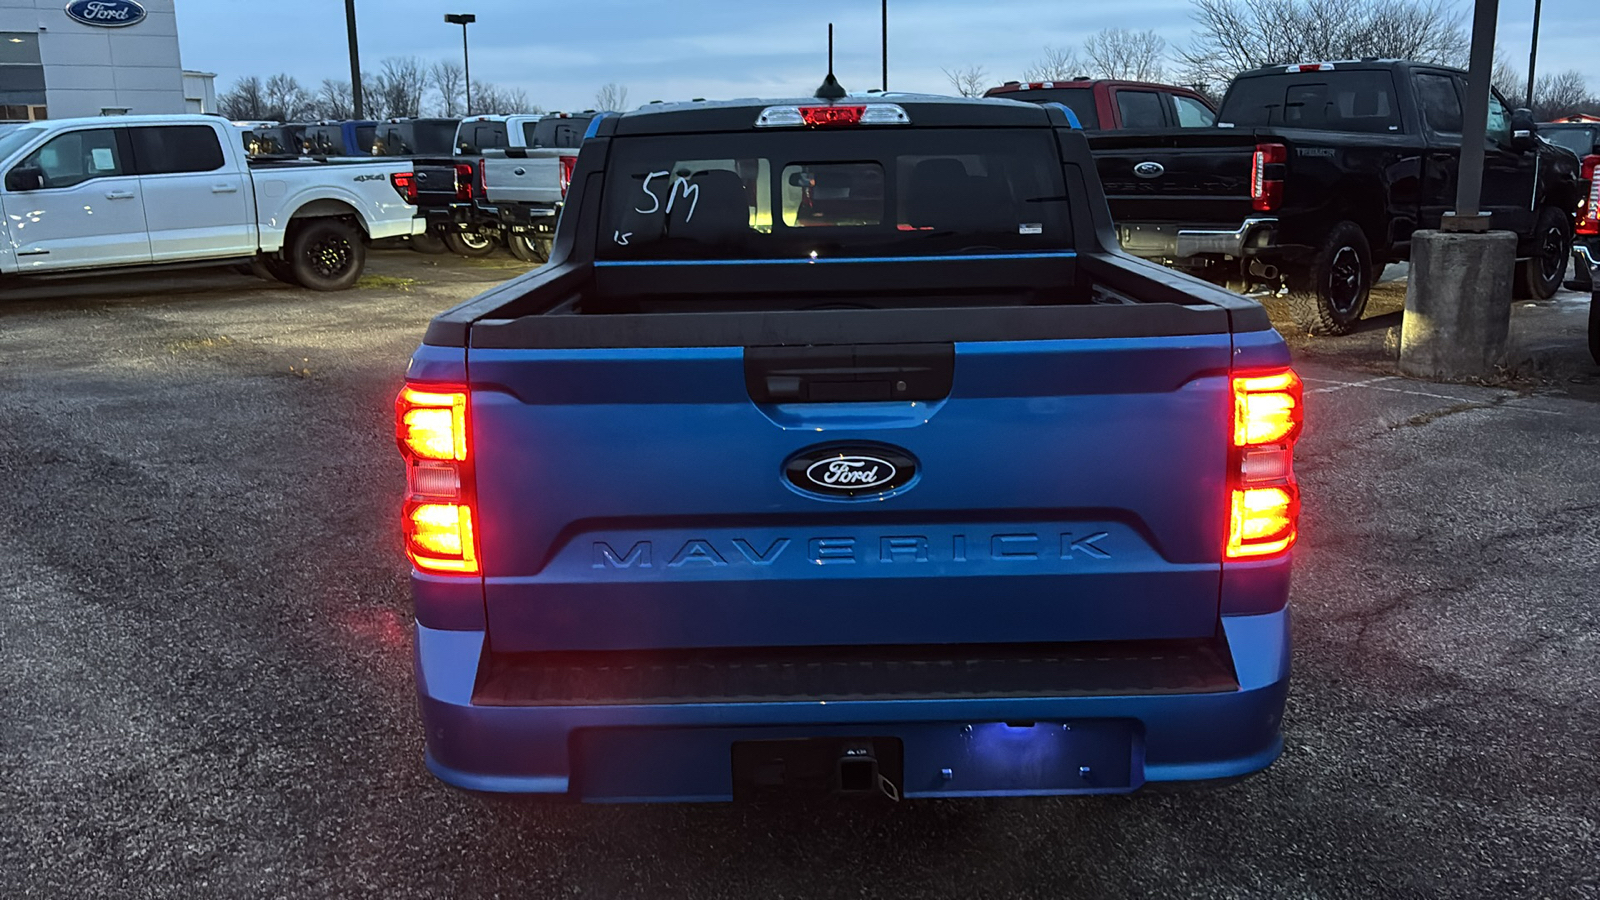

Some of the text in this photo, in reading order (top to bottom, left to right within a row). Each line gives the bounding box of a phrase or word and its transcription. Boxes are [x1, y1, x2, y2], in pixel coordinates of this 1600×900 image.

[84, 1, 128, 19] Ford
[824, 461, 878, 483] Ford
[592, 531, 1112, 569] MAVERICK
